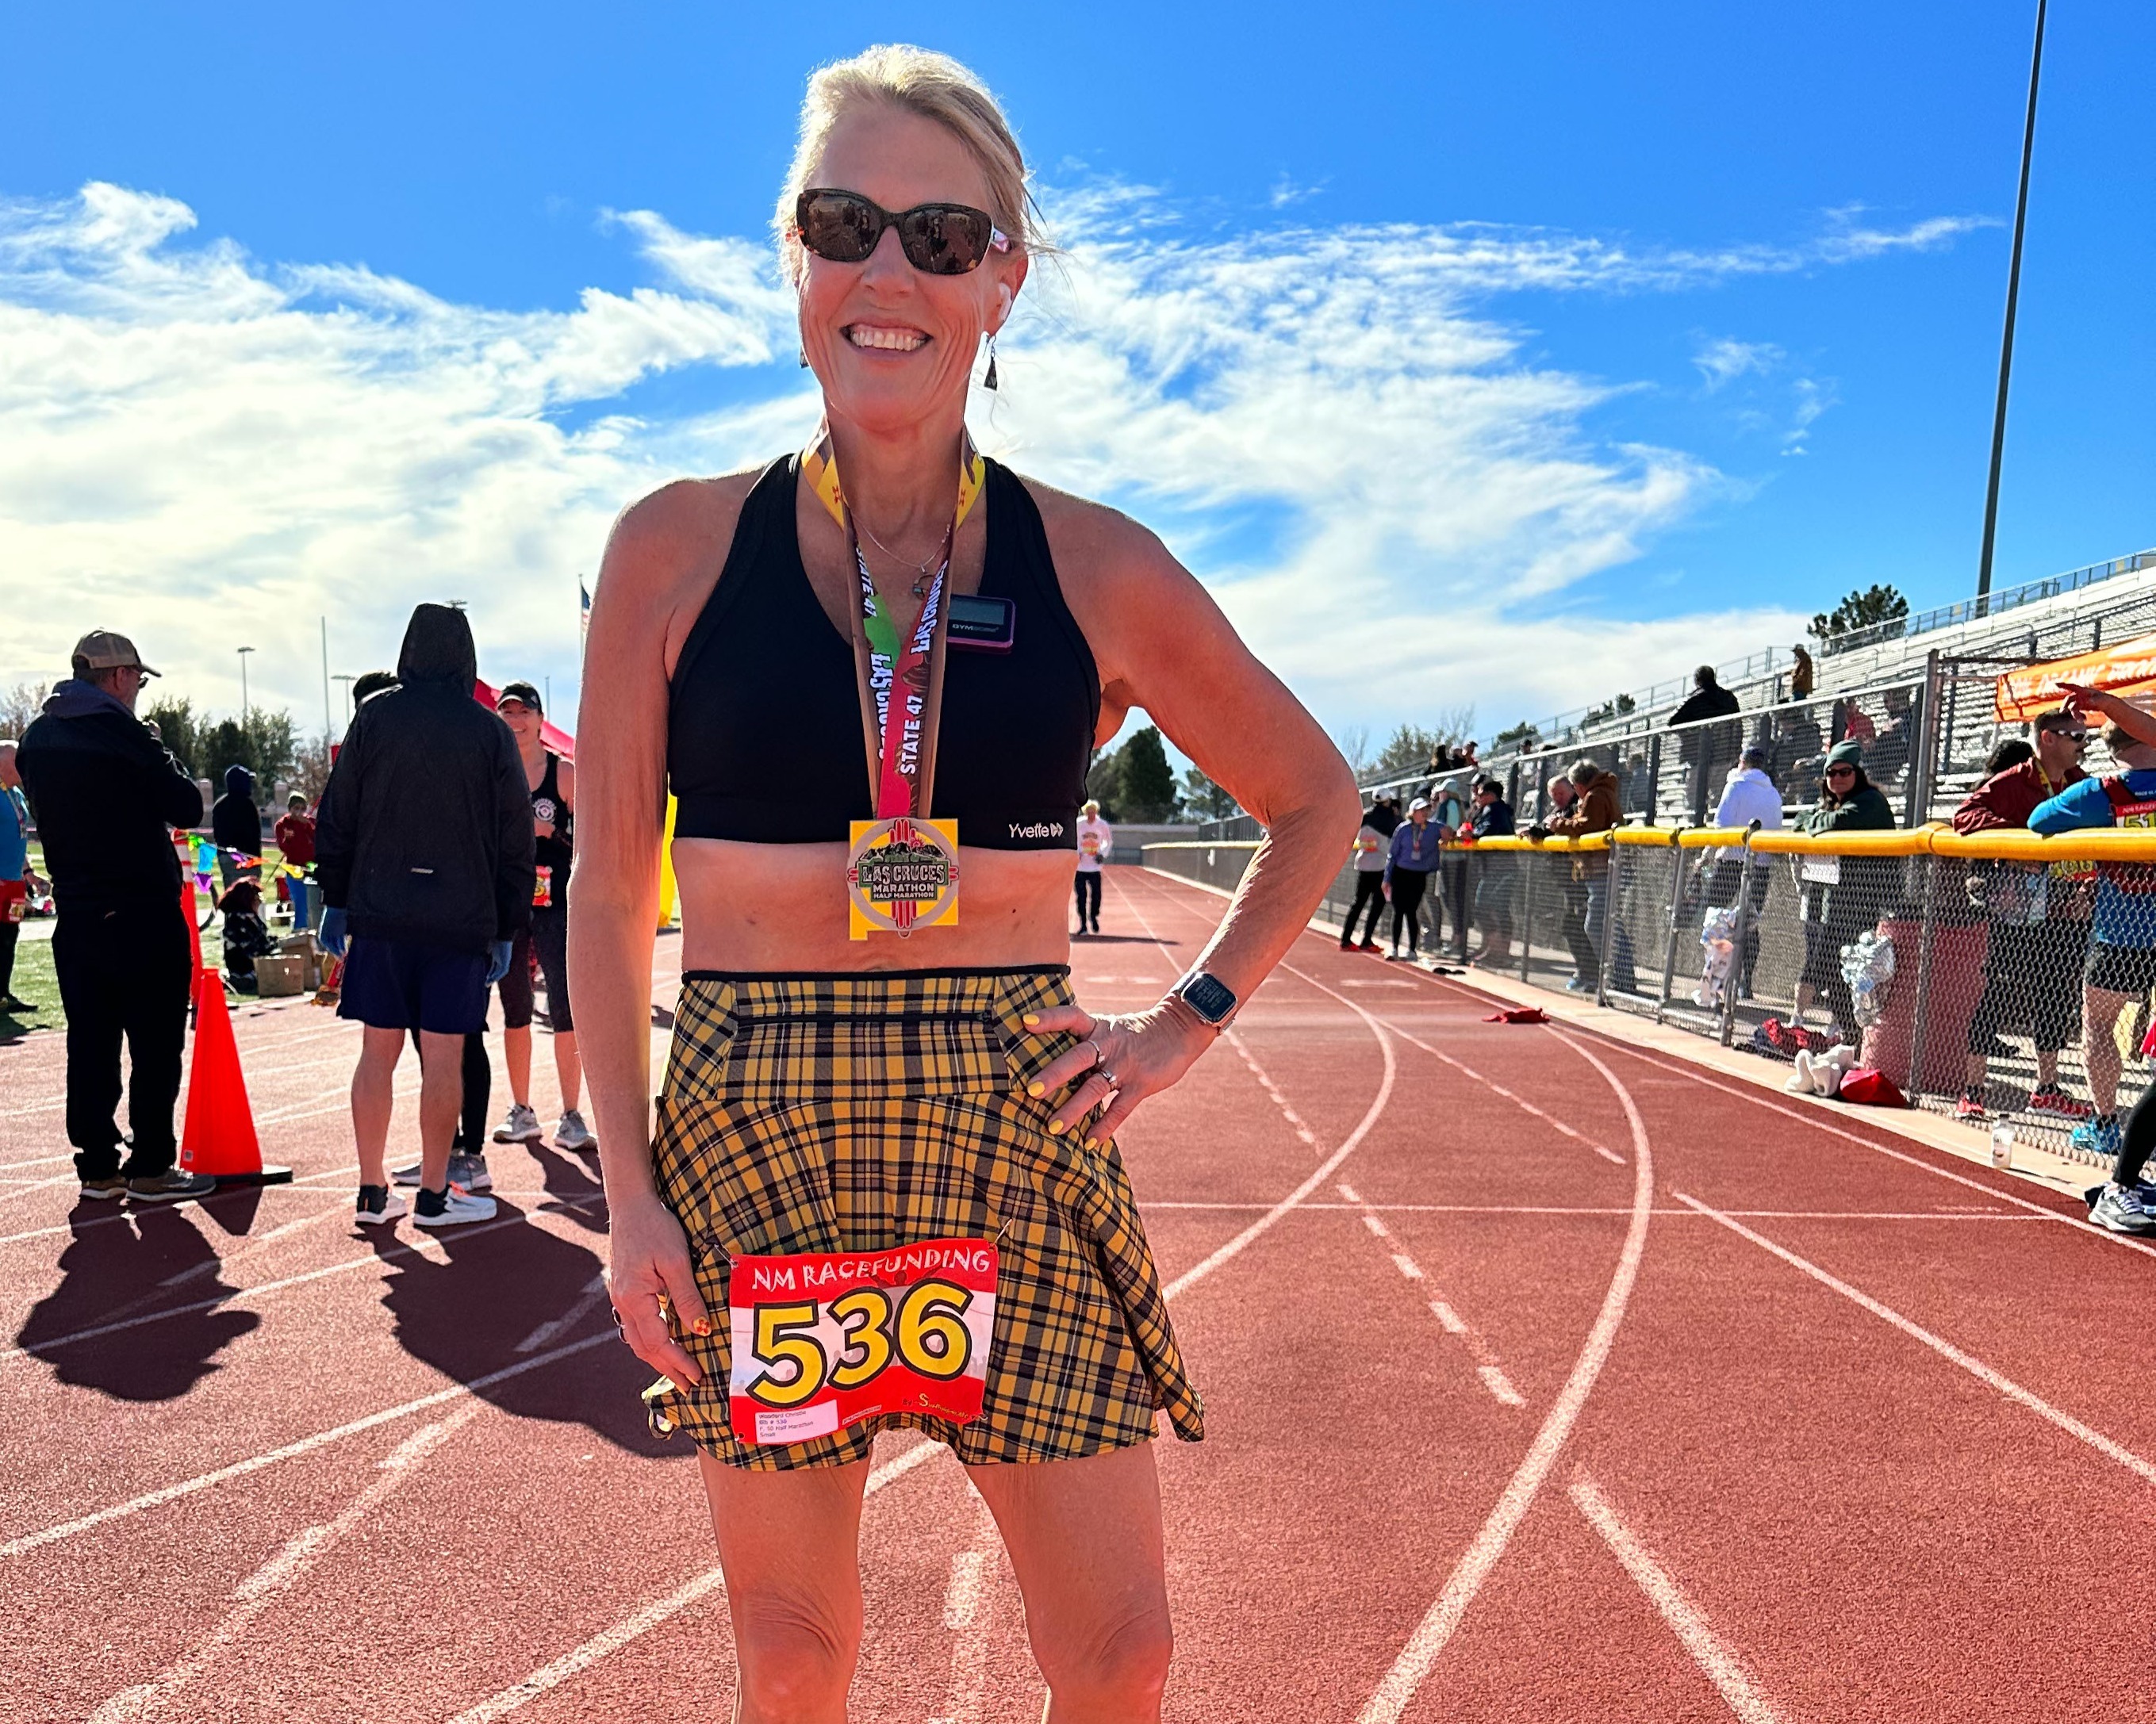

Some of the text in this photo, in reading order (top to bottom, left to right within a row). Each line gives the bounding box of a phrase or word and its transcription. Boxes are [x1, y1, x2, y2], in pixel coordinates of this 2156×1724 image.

[910, 619, 938, 654] LAS
[869, 653, 894, 689] LAS
[900, 695, 923, 775] STATE 47
[1008, 822, 1049, 838] Yvette
[862, 864, 946, 885] LAS CRUCES
[873, 883, 934, 893] MARATHON
[751, 1246, 990, 1292] NM RACEFUNDING
[745, 1278, 975, 1408] 536
